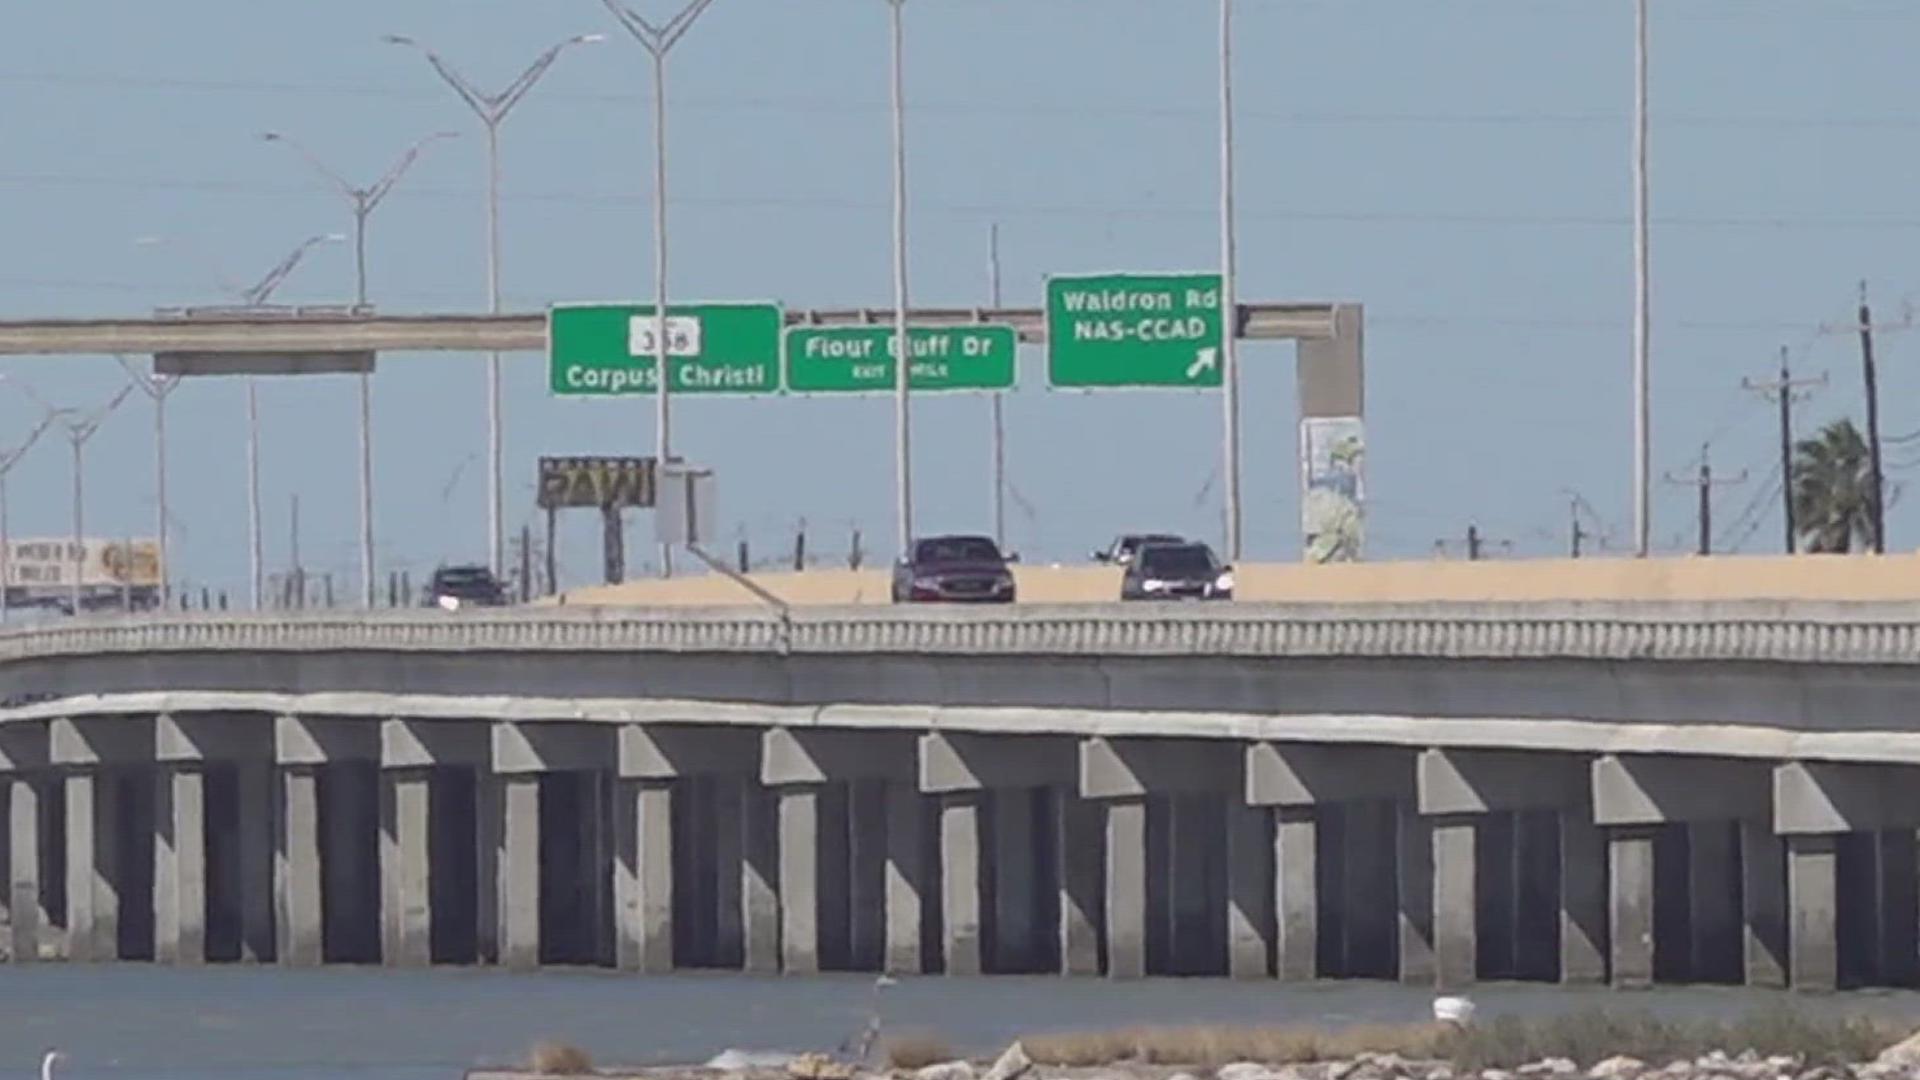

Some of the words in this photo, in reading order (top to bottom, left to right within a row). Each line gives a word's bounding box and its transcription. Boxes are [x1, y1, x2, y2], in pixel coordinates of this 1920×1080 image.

[1063, 290, 1171, 311] Waldron
[1185, 289, 1217, 309] Rd
[1075, 317, 1205, 341] NAS-CCAD
[806, 336, 874, 358] Flour
[963, 335, 992, 356] Dr
[566, 366, 658, 391] Corpus
[679, 364, 763, 386] Christi
